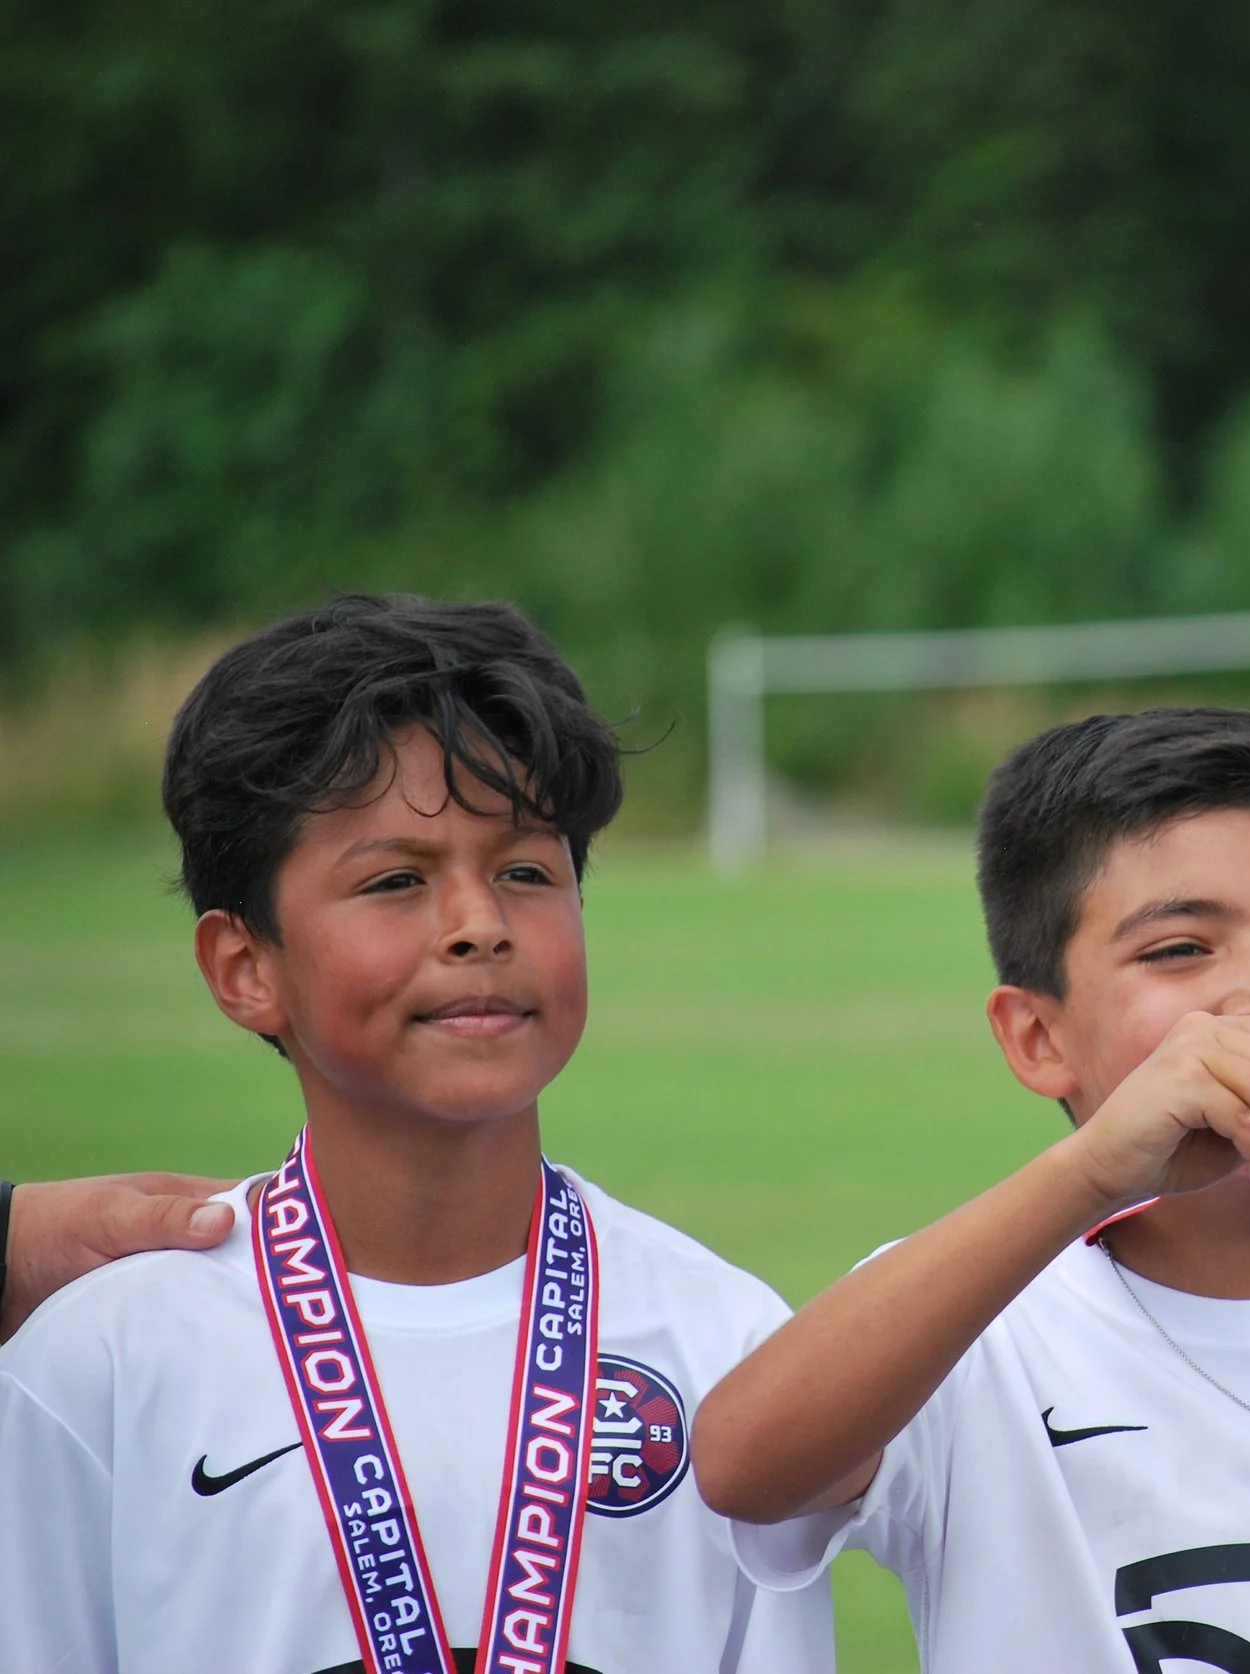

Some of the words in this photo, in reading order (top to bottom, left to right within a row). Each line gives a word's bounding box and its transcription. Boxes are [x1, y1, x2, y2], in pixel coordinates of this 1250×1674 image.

[564, 1180, 583, 1236] ORE
[536, 1189, 568, 1371] CAPITAL
[567, 1247, 586, 1335] SALEM,
[650, 1425, 672, 1442] 93
[343, 1503, 382, 1602] SALEM,
[373, 1612, 405, 1674] ORE
[353, 1454, 425, 1656] CAPITAL
